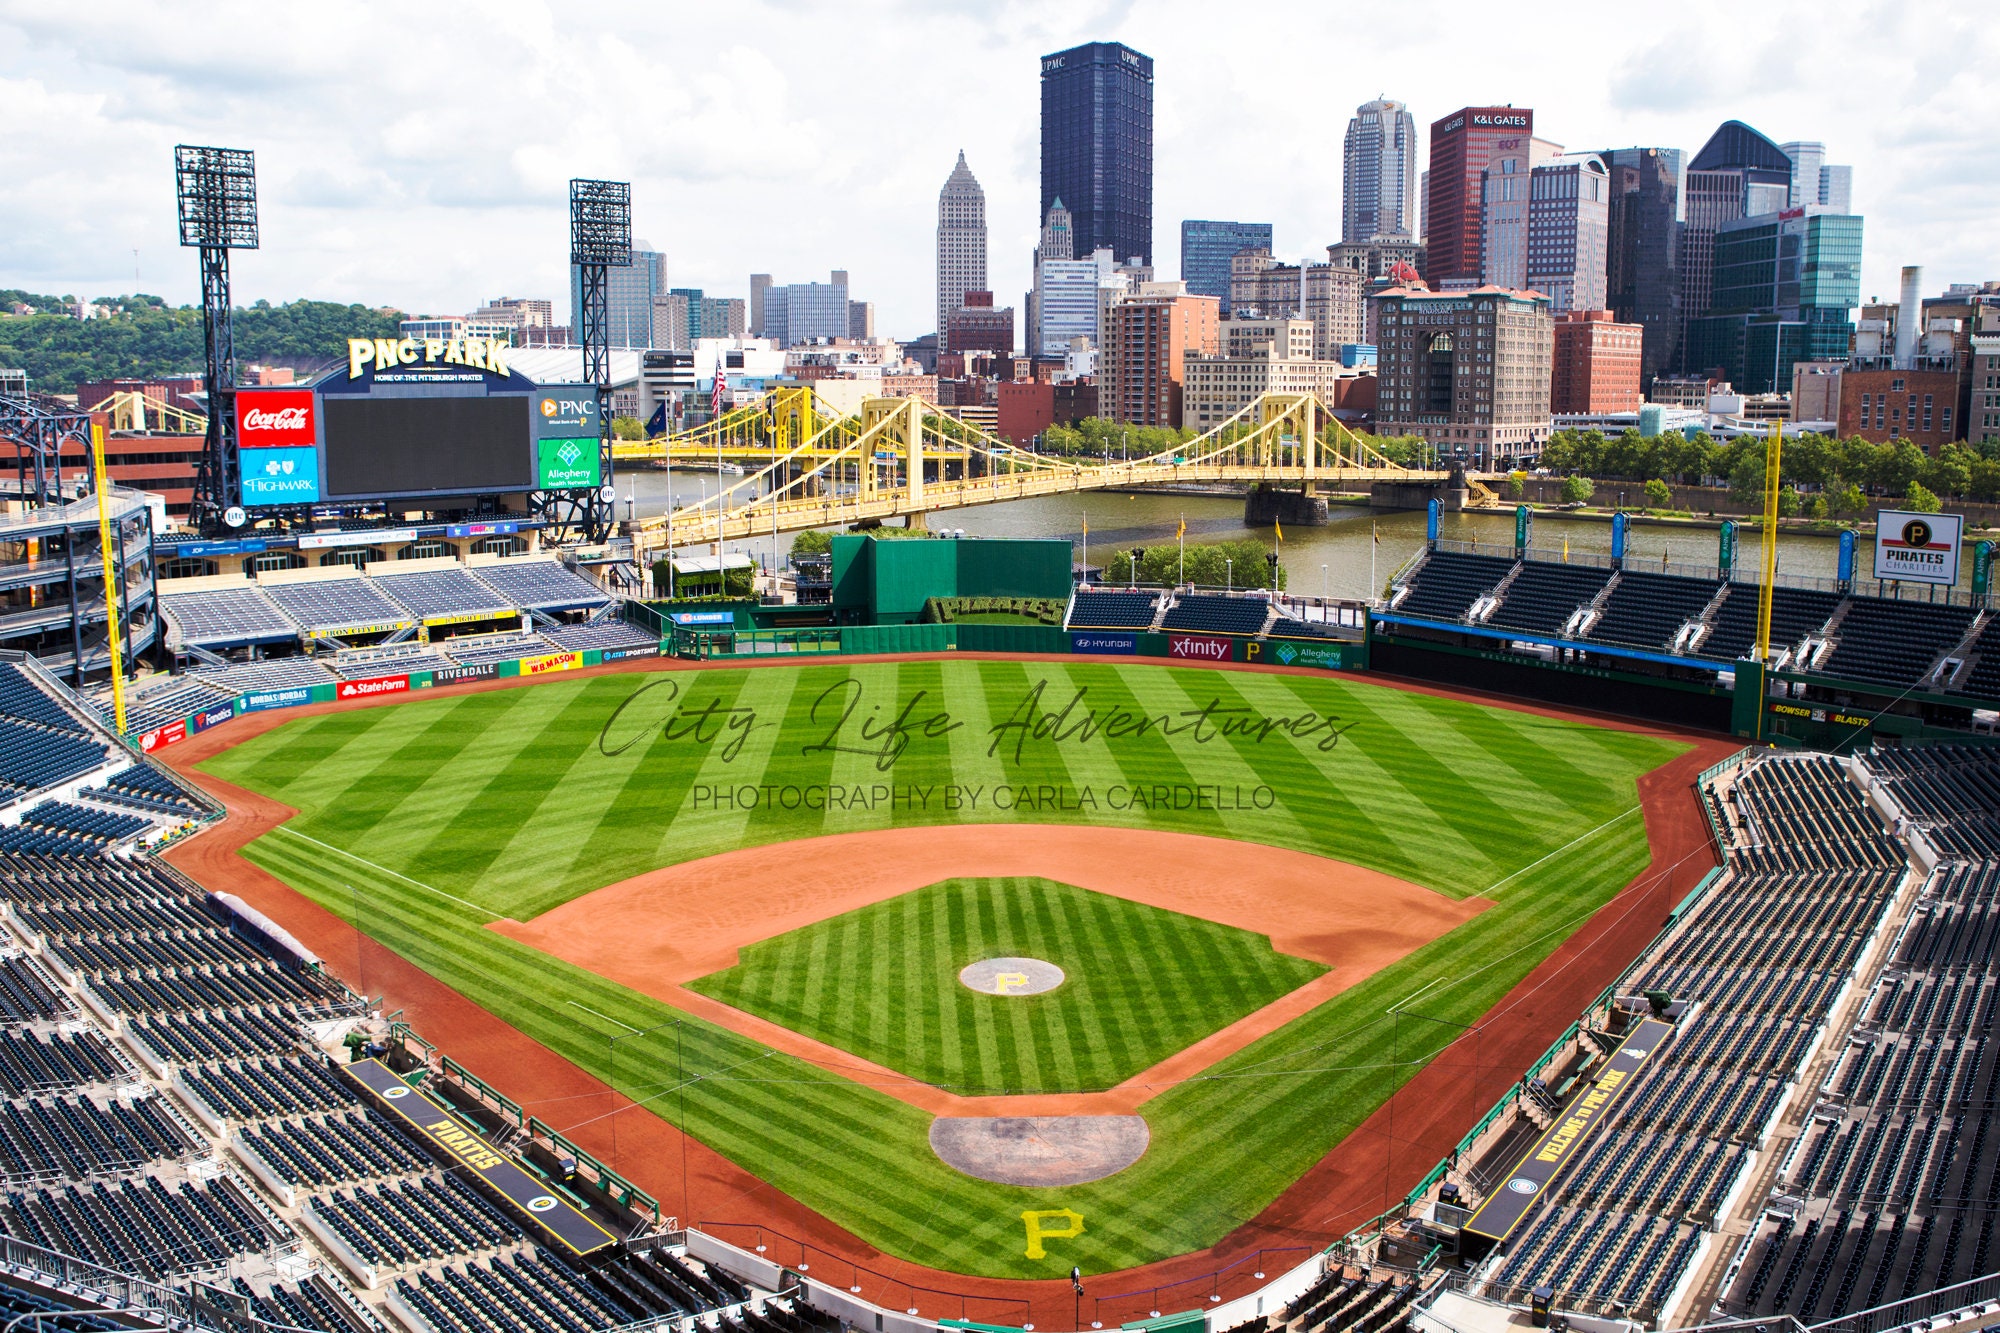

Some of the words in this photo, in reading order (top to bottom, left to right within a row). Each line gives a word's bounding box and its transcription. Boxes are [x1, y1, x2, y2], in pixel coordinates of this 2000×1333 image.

[1041, 57, 1065, 72] UPMC
[1122, 50, 1140, 67] UPMC
[1452, 117, 1463, 129] GATES
[1474, 115, 1492, 124] K&L
[1494, 116, 1527, 126] GATES
[1499, 139, 1520, 150] EQT
[347, 338, 419, 380] PNC
[425, 338, 511, 377] PARK
[374, 374, 394, 382] HOME
[394, 374, 404, 382] OF
[404, 374, 418, 382] THE
[418, 374, 448, 382] PITTSBURGH
[448, 374, 483, 382] PIRATES
[559, 400, 594, 415] PNC
[243, 408, 309, 430] Coca-Cola
[548, 469, 591, 480] Allegheny
[243, 477, 316, 492] HIGHMARK
[603, 490, 614, 498] Lite
[228, 511, 243, 521] Lite
[1911, 526, 1924, 543] P
[1886, 550, 1944, 565] PIRATES
[1886, 561, 1944, 574] CHARITIES
[326, 629, 349, 637] IRON
[352, 626, 372, 634] CITY
[374, 624, 398, 632] BEER
[1092, 640, 1132, 648] HYUNDAI
[1173, 638, 1227, 659] xfinity
[1246, 642, 1260, 660] P
[611, 651, 625, 659] AT&T
[626, 647, 659, 657] SPORTSNET
[1300, 649, 1341, 659] Allegheny
[438, 664, 494, 680] RIVENDALE
[1481, 653, 1528, 665] WELCOME
[1582, 668, 1610, 678] PARK
[250, 694, 278, 704] BORDAS
[280, 690, 307, 701] BORDAS
[206, 708, 232, 725] Fanatics
[1776, 704, 1811, 717] BOWSER
[1834, 714, 1870, 727] BLASTS
[995, 972, 1030, 994] P
[1596, 1068, 1627, 1093] PARK
[1581, 1089, 1610, 1110] PNC
[1575, 1108, 1594, 1118] TO
[426, 1120, 503, 1170] PIRATES
[1536, 1116, 1588, 1162] WELCOME
[1020, 1207, 1088, 1260] P
